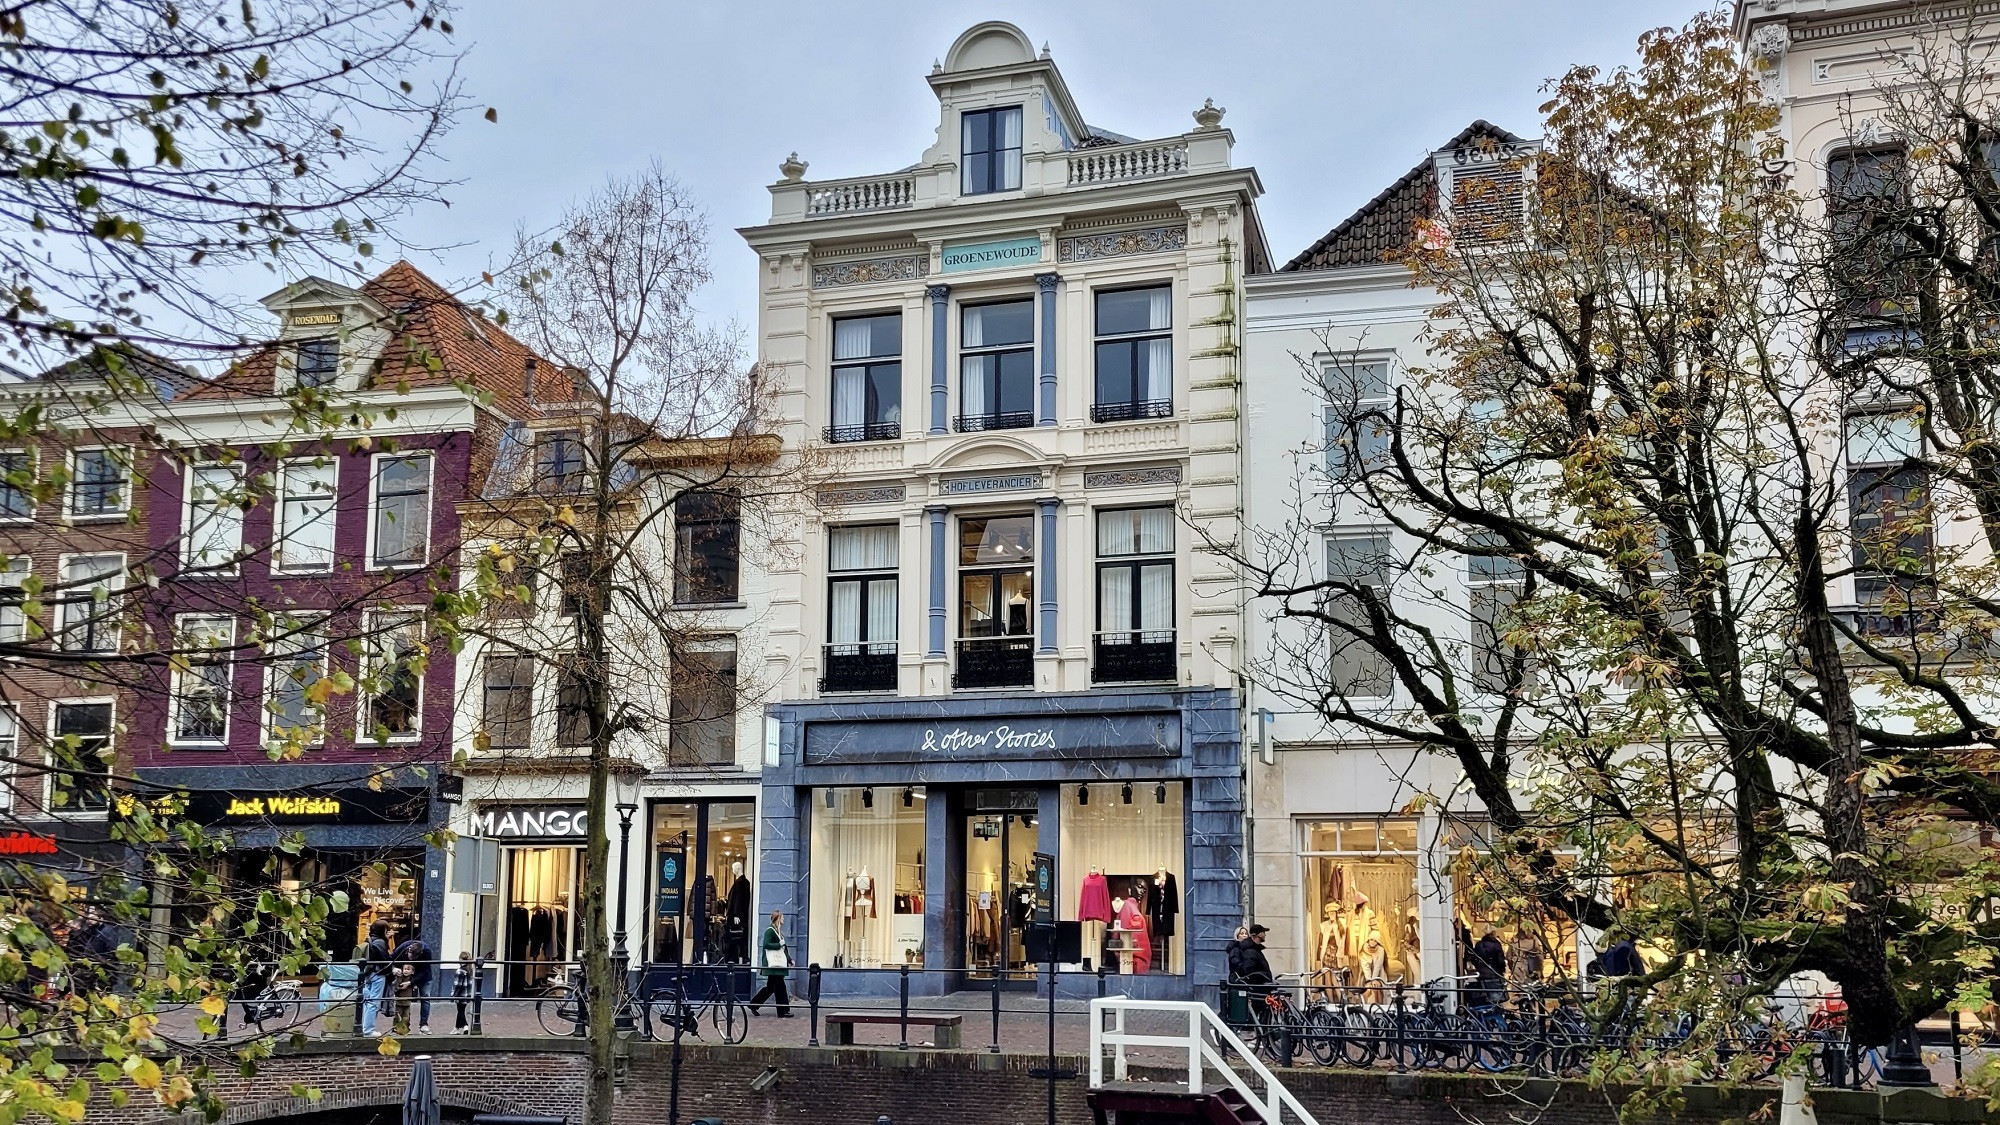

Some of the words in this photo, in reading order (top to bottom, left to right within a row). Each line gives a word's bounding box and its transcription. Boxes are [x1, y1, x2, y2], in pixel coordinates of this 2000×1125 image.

[944, 245, 1039, 266] GROENEWOUDE
[294, 314, 340, 326] ROSENDAEL
[951, 477, 1032, 492] HOFLEVERANCIER
[921, 729, 939, 751] &
[940, 727, 994, 751] other
[995, 725, 1056, 749] Stories
[443, 792, 462, 801] MANGO
[226, 798, 265, 815] Jack
[267, 797, 340, 815] Wolfskin
[470, 810, 588, 836] MANGO
[373, 897, 406, 905] Discover
